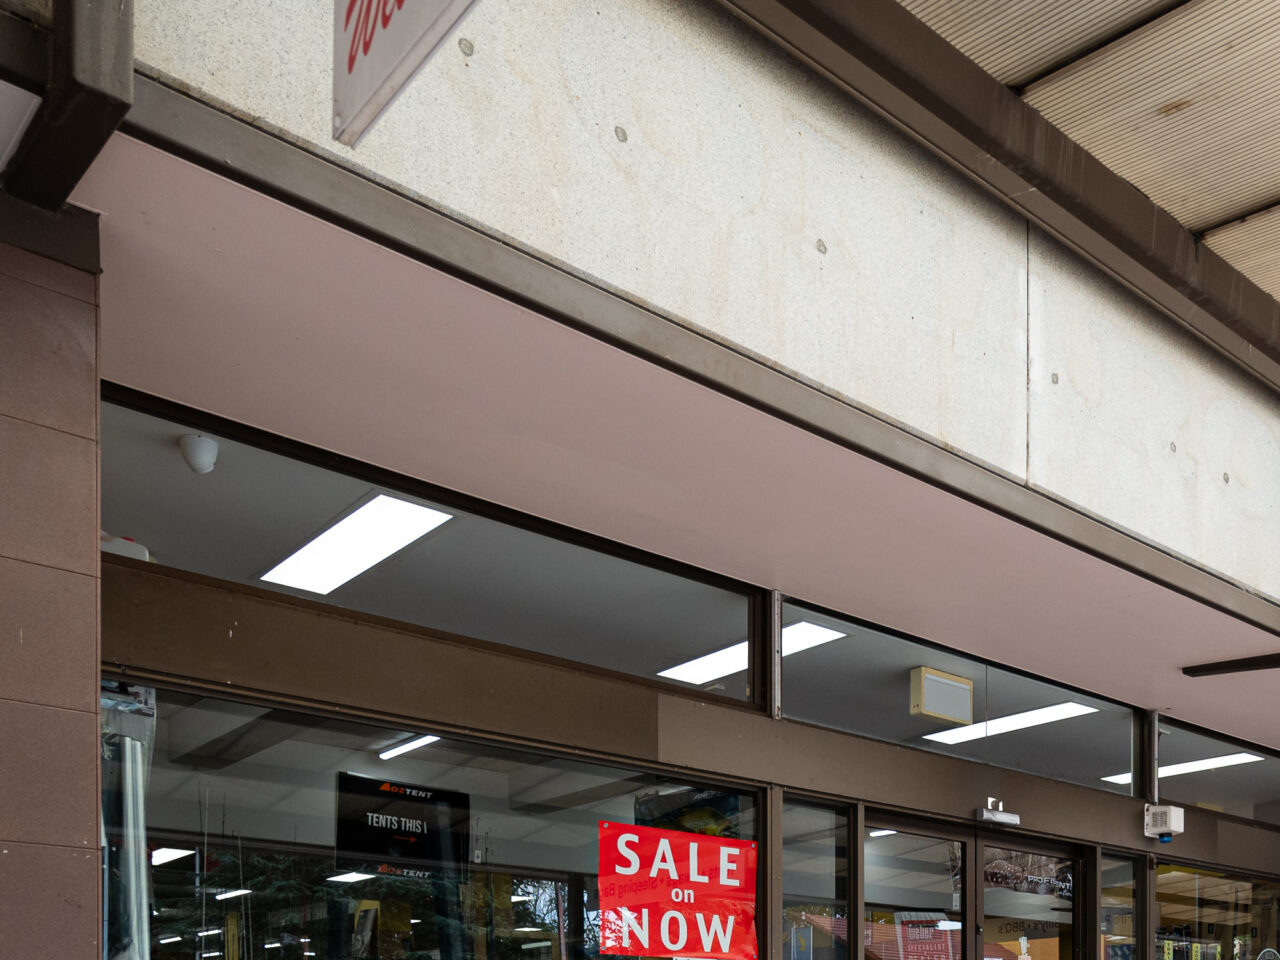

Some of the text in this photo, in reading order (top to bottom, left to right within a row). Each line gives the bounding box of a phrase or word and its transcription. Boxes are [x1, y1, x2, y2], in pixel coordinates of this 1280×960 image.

[366, 811, 398, 829] TENTS
[400, 817, 422, 833] THIS
[614, 832, 741, 887] SALE
[671, 887, 695, 904] on
[616, 906, 735, 953] NOW
